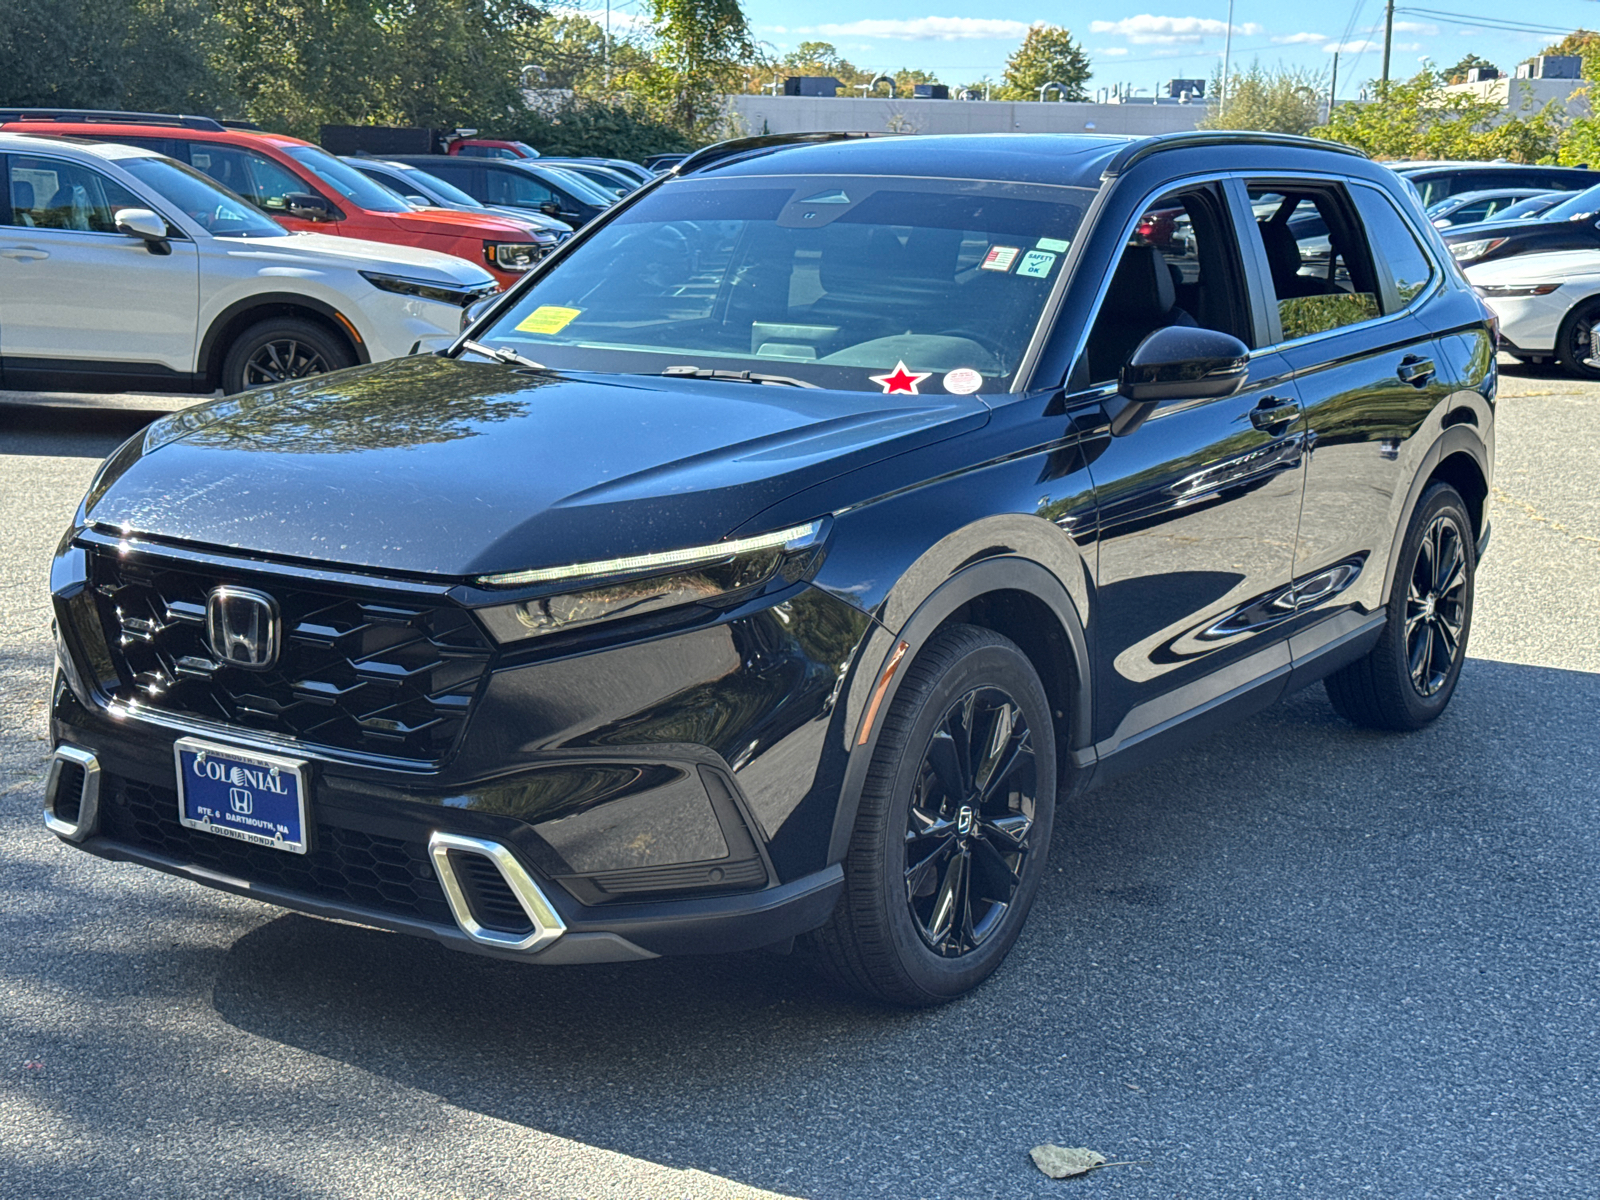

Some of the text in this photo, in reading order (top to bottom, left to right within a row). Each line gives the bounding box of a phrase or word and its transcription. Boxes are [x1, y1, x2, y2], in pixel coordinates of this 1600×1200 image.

[1028, 253, 1053, 261] SAFETY
[193, 758, 288, 795] COLONIAL
[197, 806, 289, 834] RTE. 6 DARTMOUTH, MA
[210, 825, 275, 847] COLONIAL HONDA
